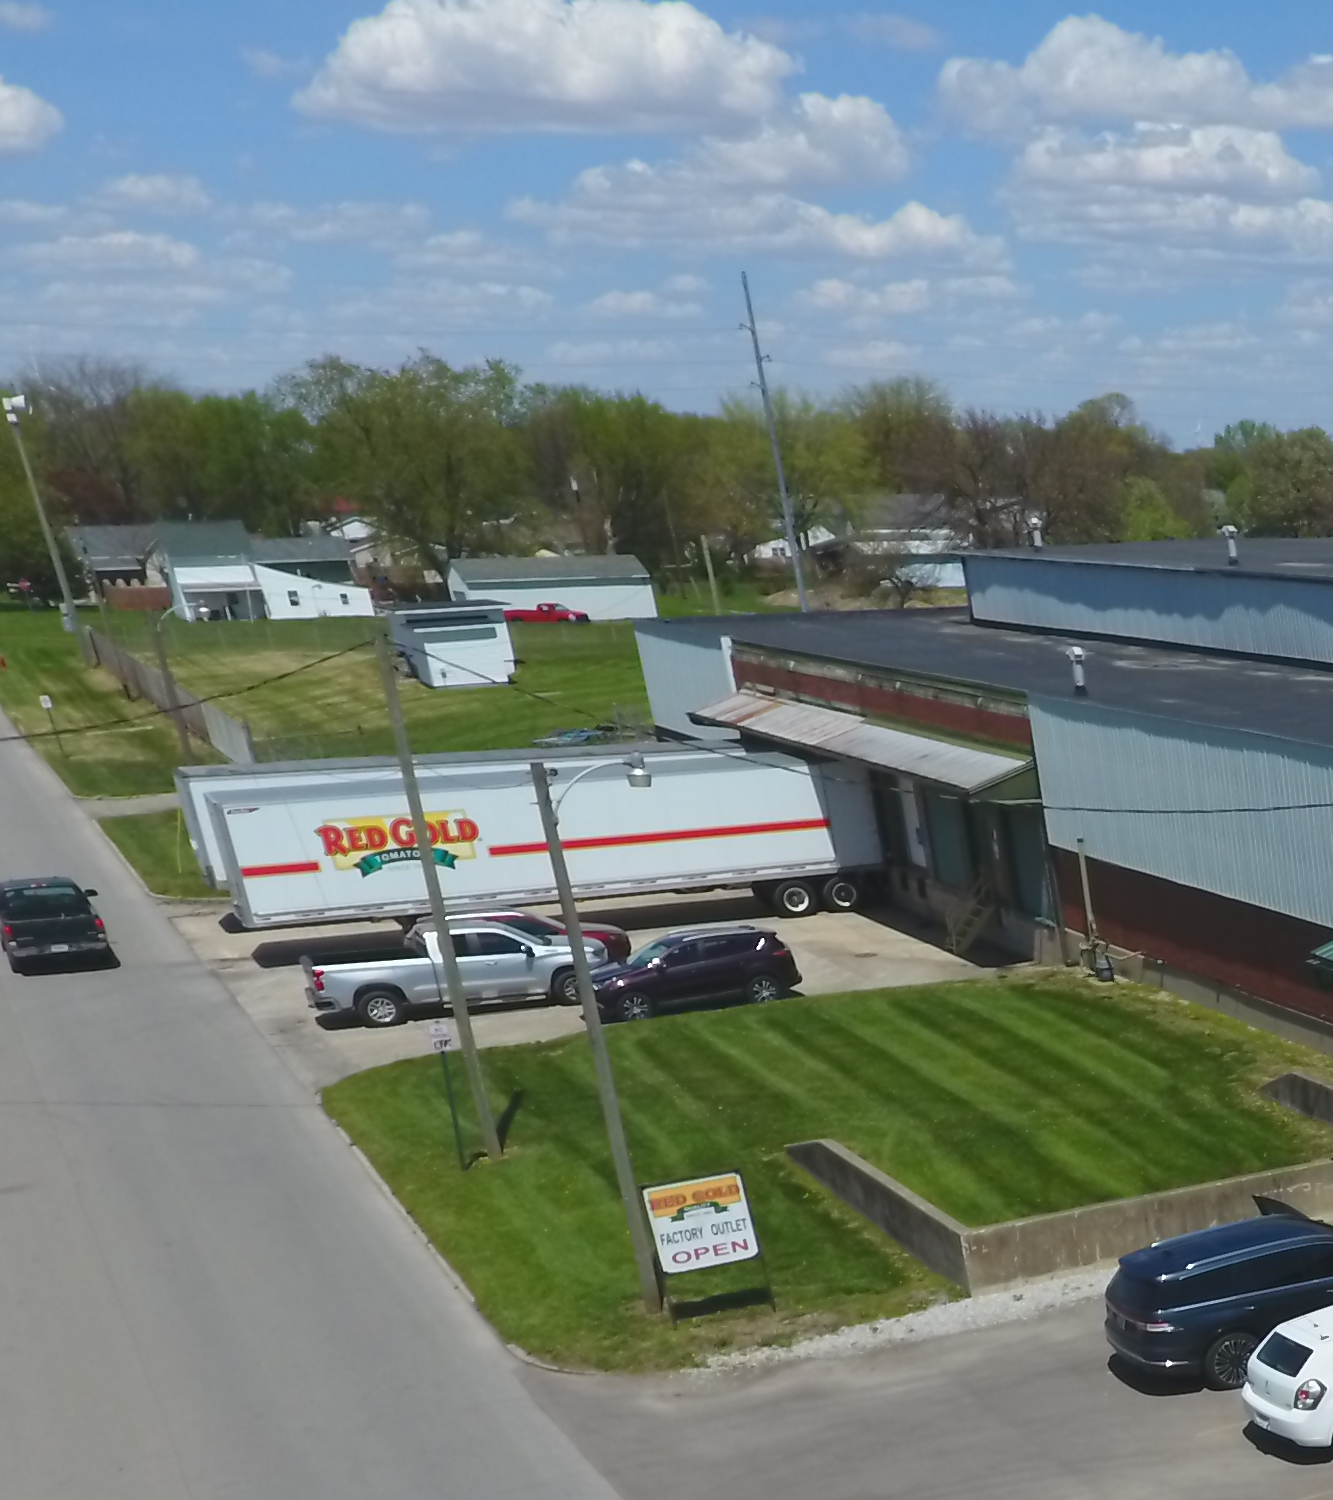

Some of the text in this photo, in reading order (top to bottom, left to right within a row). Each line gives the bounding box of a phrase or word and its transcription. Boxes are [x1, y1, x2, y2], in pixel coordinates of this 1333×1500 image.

[314, 824, 388, 857] RED
[374, 851, 434, 863] TOMATO
[649, 1193, 687, 1211] RED
[692, 1184, 740, 1202] GOLD
[660, 1218, 748, 1246] FACTORY OUTLET
[671, 1238, 749, 1264] OPEN
